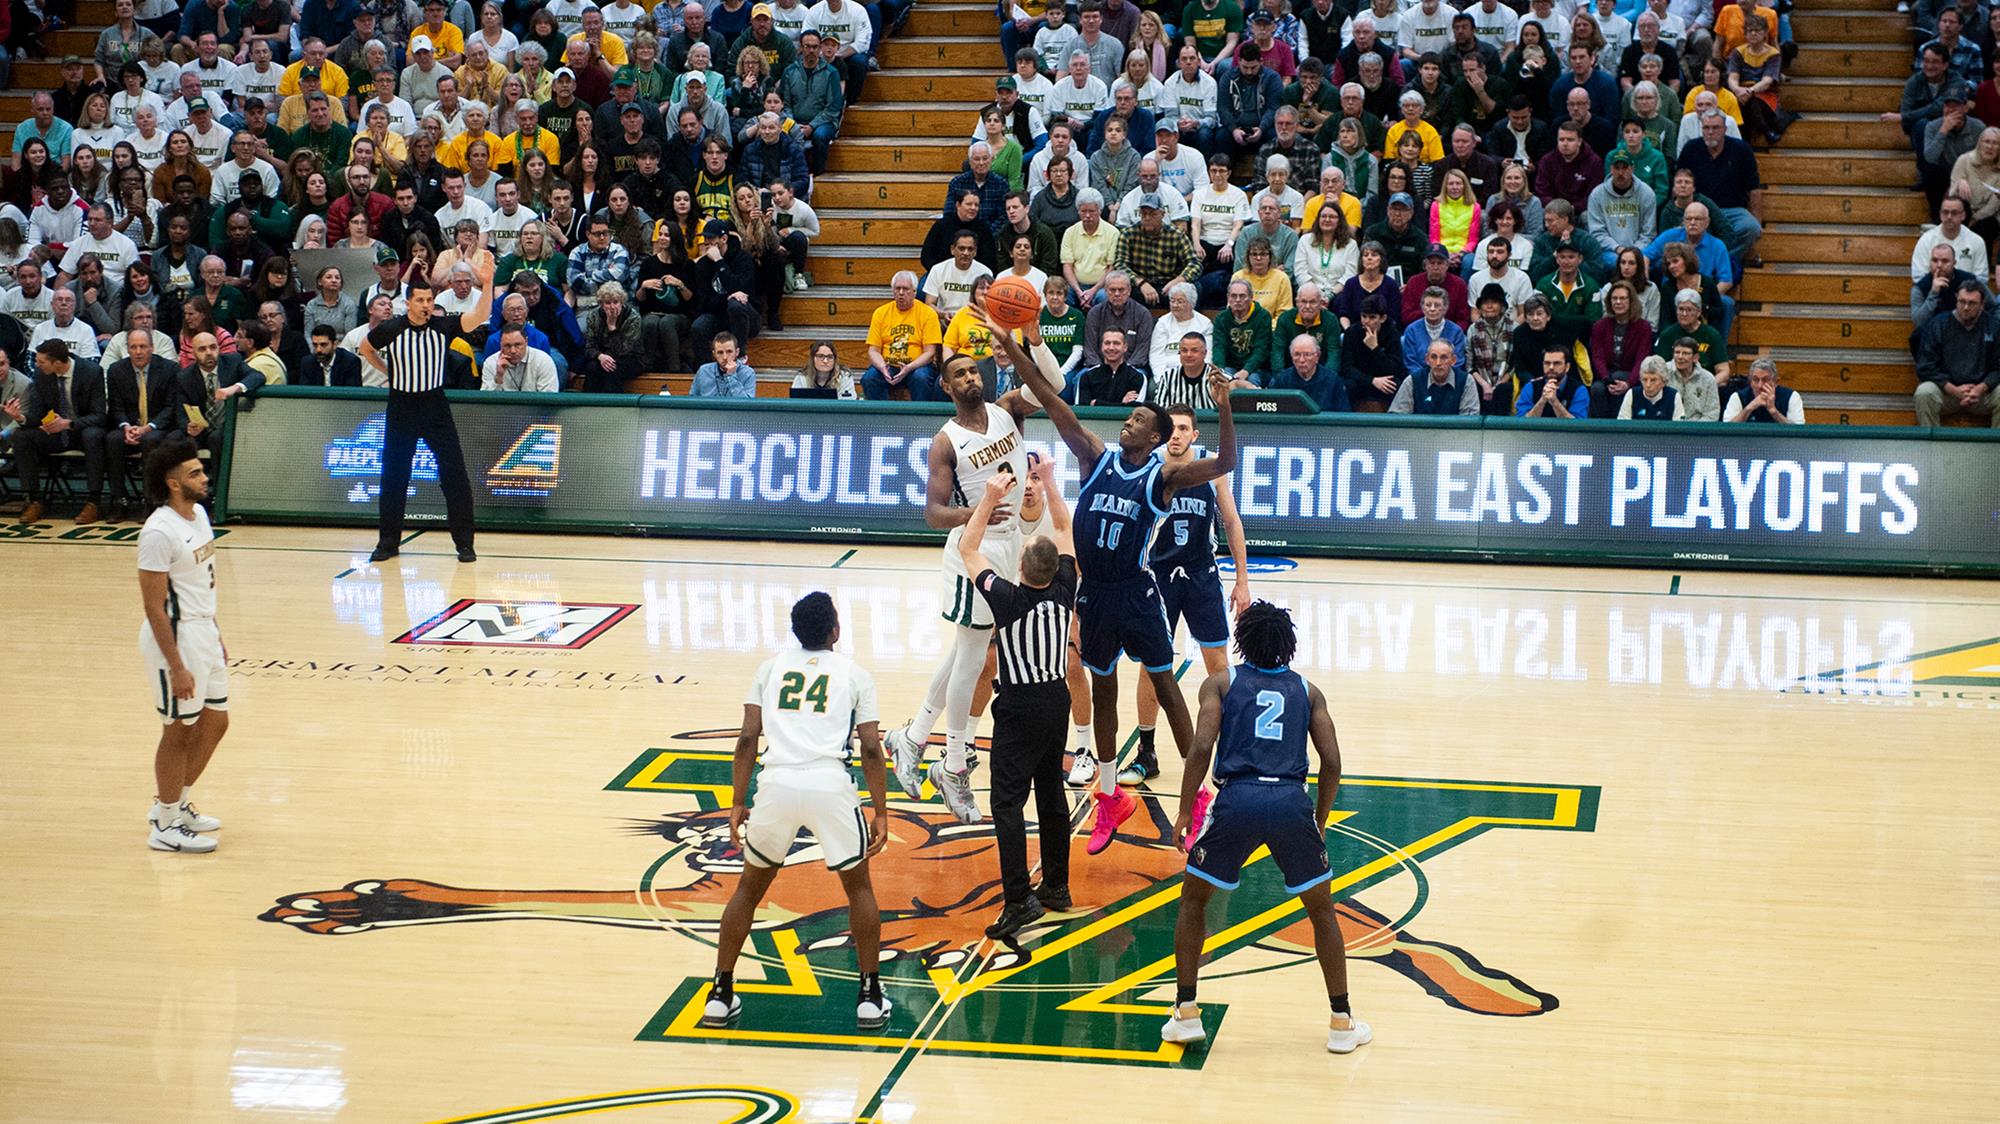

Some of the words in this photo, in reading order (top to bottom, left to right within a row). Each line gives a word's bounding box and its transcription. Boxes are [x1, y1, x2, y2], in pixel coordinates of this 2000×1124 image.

[819, 23, 850, 32] VERMONT
[952, 15, 961, 27] L
[1416, 28, 1447, 36] VERMONT
[938, 47, 946, 59] K
[1843, 54, 1852, 67] K
[924, 80, 932, 92] J
[894, 150, 902, 162] H
[879, 186, 887, 199] G
[1202, 204, 1235, 214] VERMONT
[1842, 199, 1852, 213] G
[863, 222, 870, 236] F
[1843, 239, 1852, 253] F
[846, 262, 855, 275] E
[1842, 279, 1851, 294] E
[829, 302, 837, 316] D
[890, 324, 916, 337] DEFEND
[1842, 322, 1851, 338] D
[1841, 367, 1850, 382] C
[1256, 402, 1278, 412] POSS
[968, 431, 1020, 469] VERMONT
[641, 429, 933, 509] HERCULES
[1232, 447, 1416, 520] ERICA
[1436, 451, 1593, 525] EAST
[1612, 456, 1919, 535] PLAYOFFS
[1169, 497, 1207, 517] AINE
[811, 526, 862, 534] DAKTRONICS
[1097, 519, 1125, 550] 10
[1173, 520, 1190, 546] 5
[1246, 539, 1287, 547] KTRONICS
[1673, 552, 1730, 560] DAKTRONICS
[405, 646, 473, 655] SINCE
[490, 648, 548, 658] 1828
[229, 657, 464, 676] ERMONT
[473, 666, 701, 686] MUTUAL
[229, 670, 465, 684] NSURANCE
[490, 680, 645, 692] GROUP
[777, 669, 831, 713] 24
[1255, 690, 1286, 741] 2
